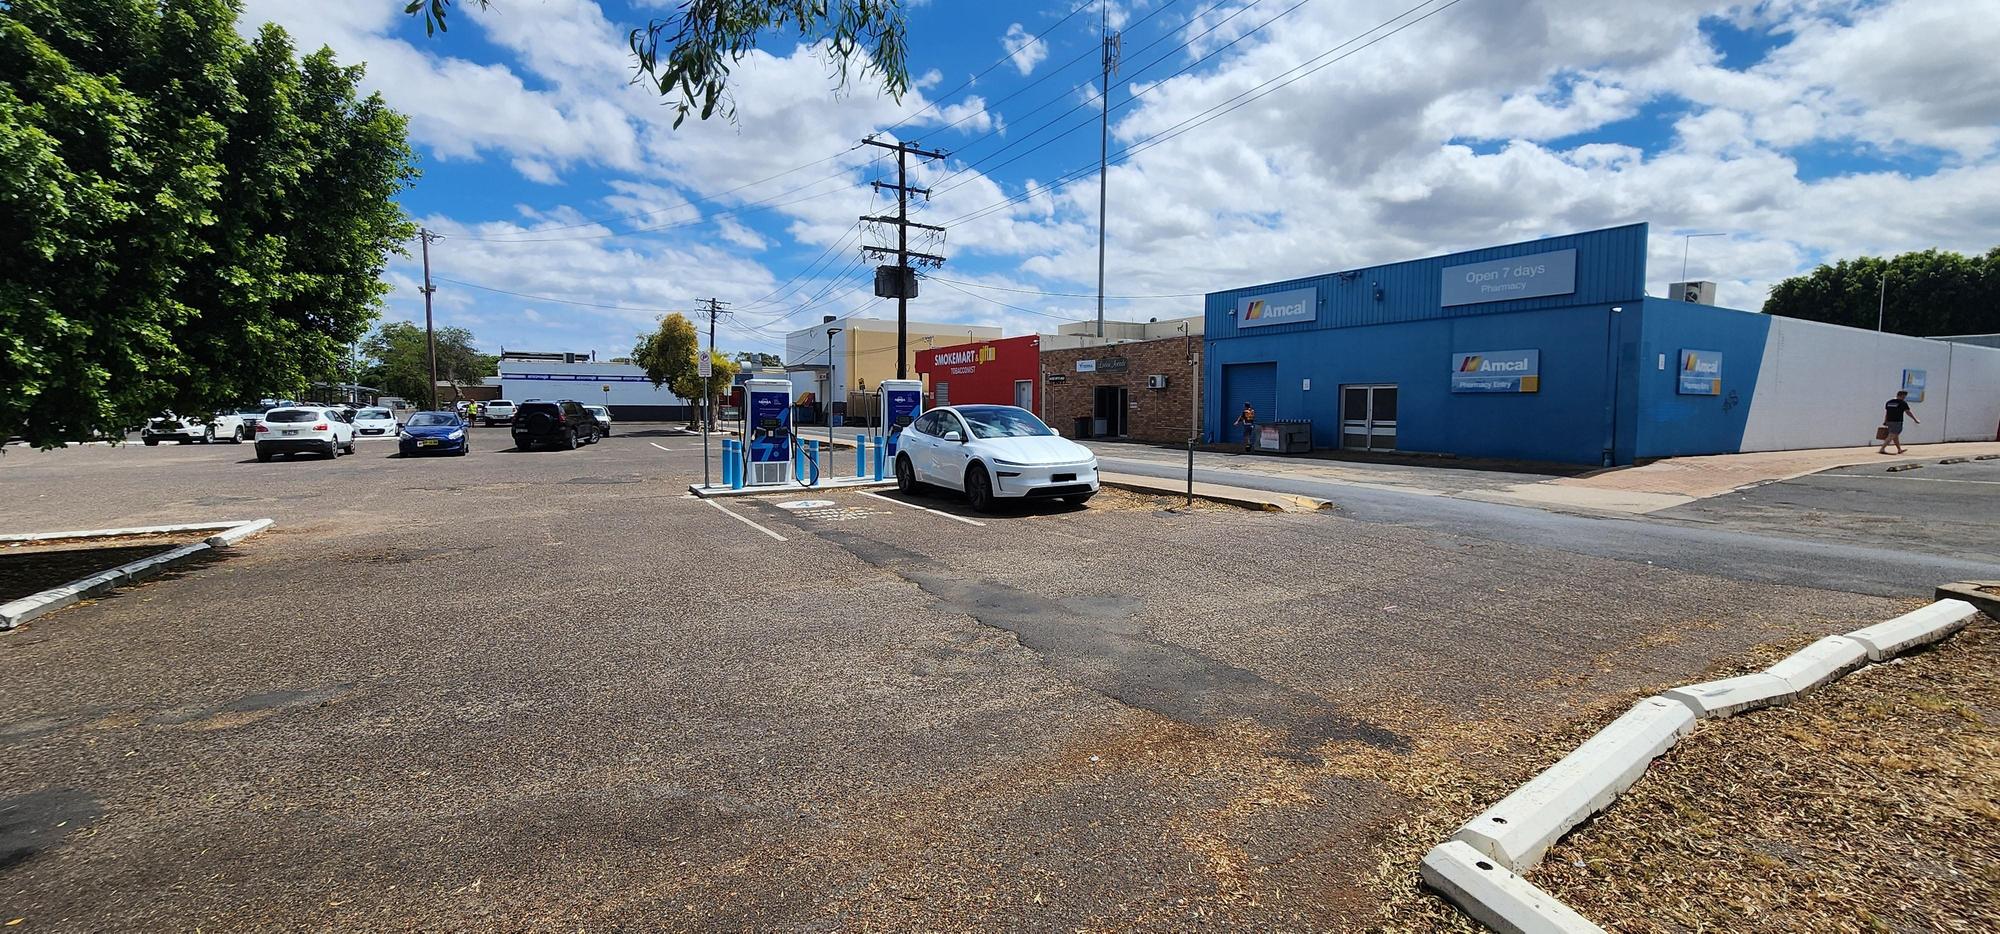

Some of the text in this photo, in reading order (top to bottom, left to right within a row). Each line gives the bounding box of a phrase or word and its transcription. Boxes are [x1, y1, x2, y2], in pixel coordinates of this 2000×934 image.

[1466, 264, 1545, 284] Open 7 days
[1481, 281, 1527, 293] Pharmacy
[1264, 300, 1306, 318] Amcal
[934, 350, 975, 366] SMOKEMART
[1480, 358, 1528, 372] Amcal
[1695, 359, 1718, 373] Amcal
[1460, 381, 1491, 389] Pharmacy
